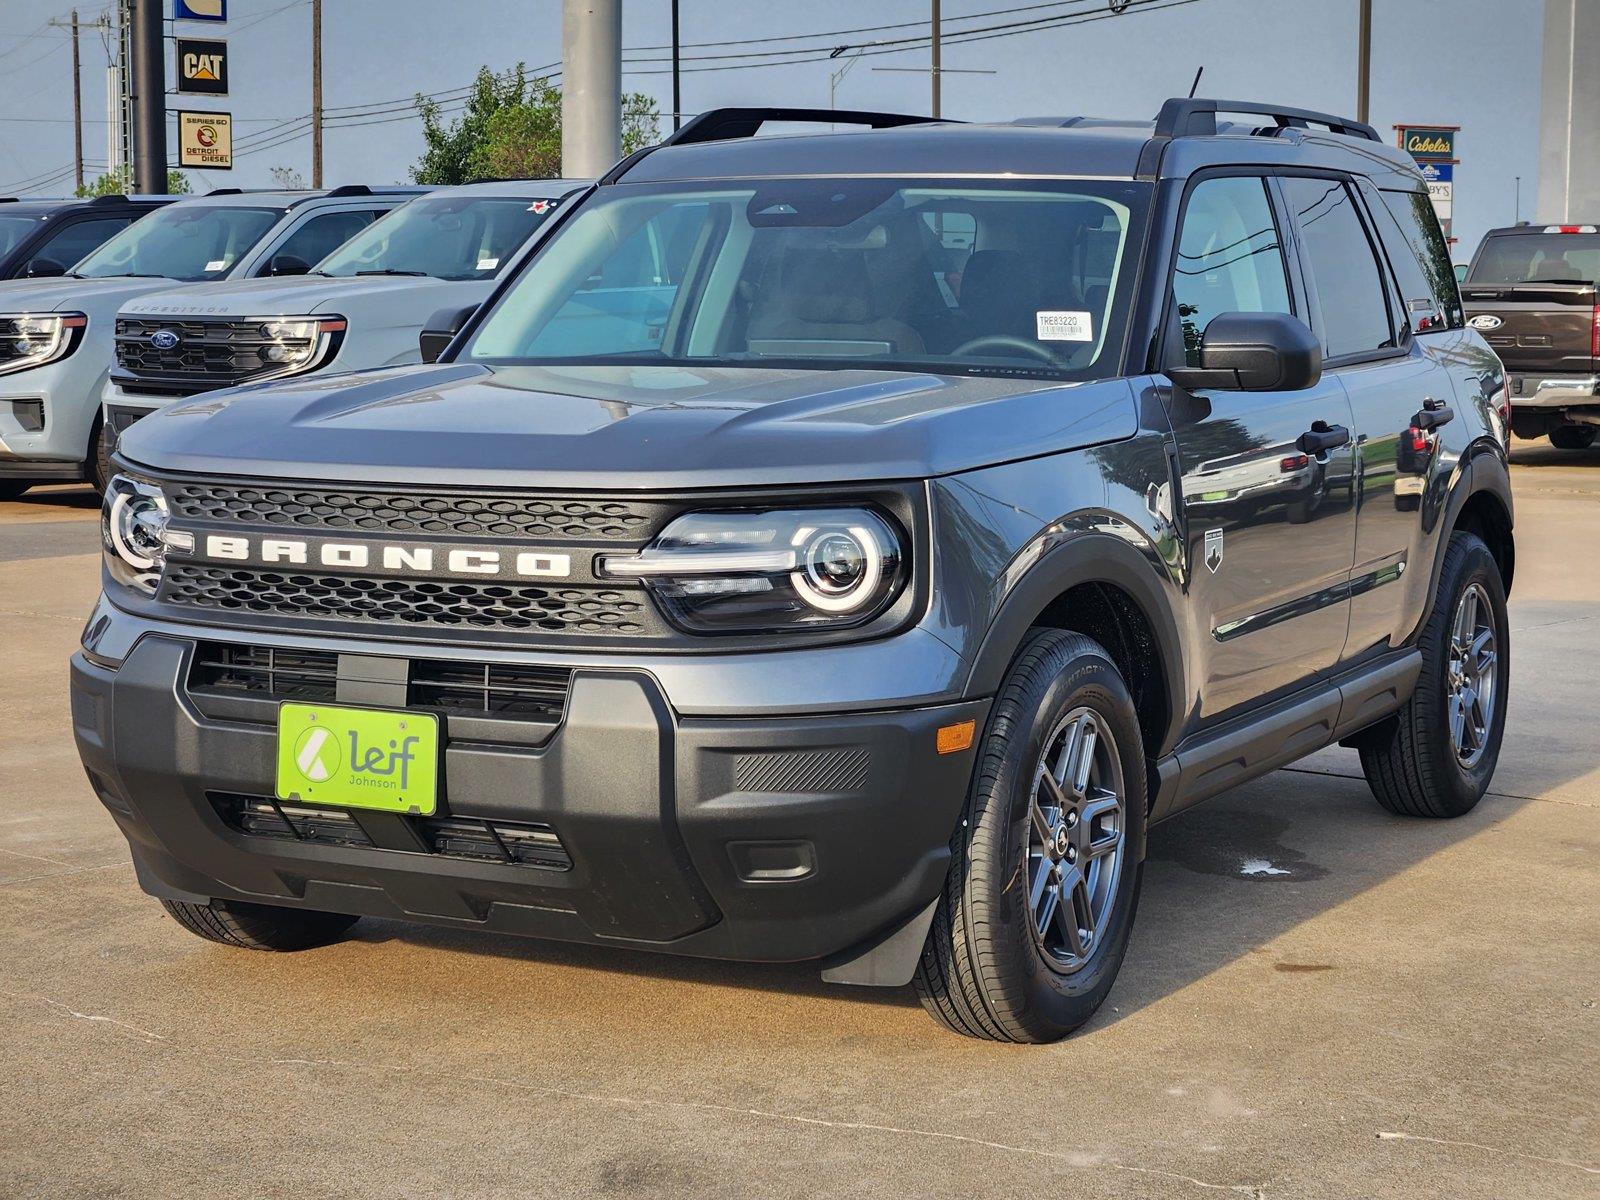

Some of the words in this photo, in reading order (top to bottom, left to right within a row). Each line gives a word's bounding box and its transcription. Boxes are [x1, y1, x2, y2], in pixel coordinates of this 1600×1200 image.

[183, 53, 224, 81] CAT
[186, 117, 216, 125] SERIES
[186, 147, 219, 155] DETROIT
[1408, 136, 1451, 153] Cabela's
[201, 155, 229, 163] DIESEL
[1429, 185, 1450, 197] BY'S
[1040, 316, 1077, 326] TRE83220
[206, 535, 571, 577] BRONCO
[348, 730, 420, 790] leif
[349, 775, 396, 790] Johnson
